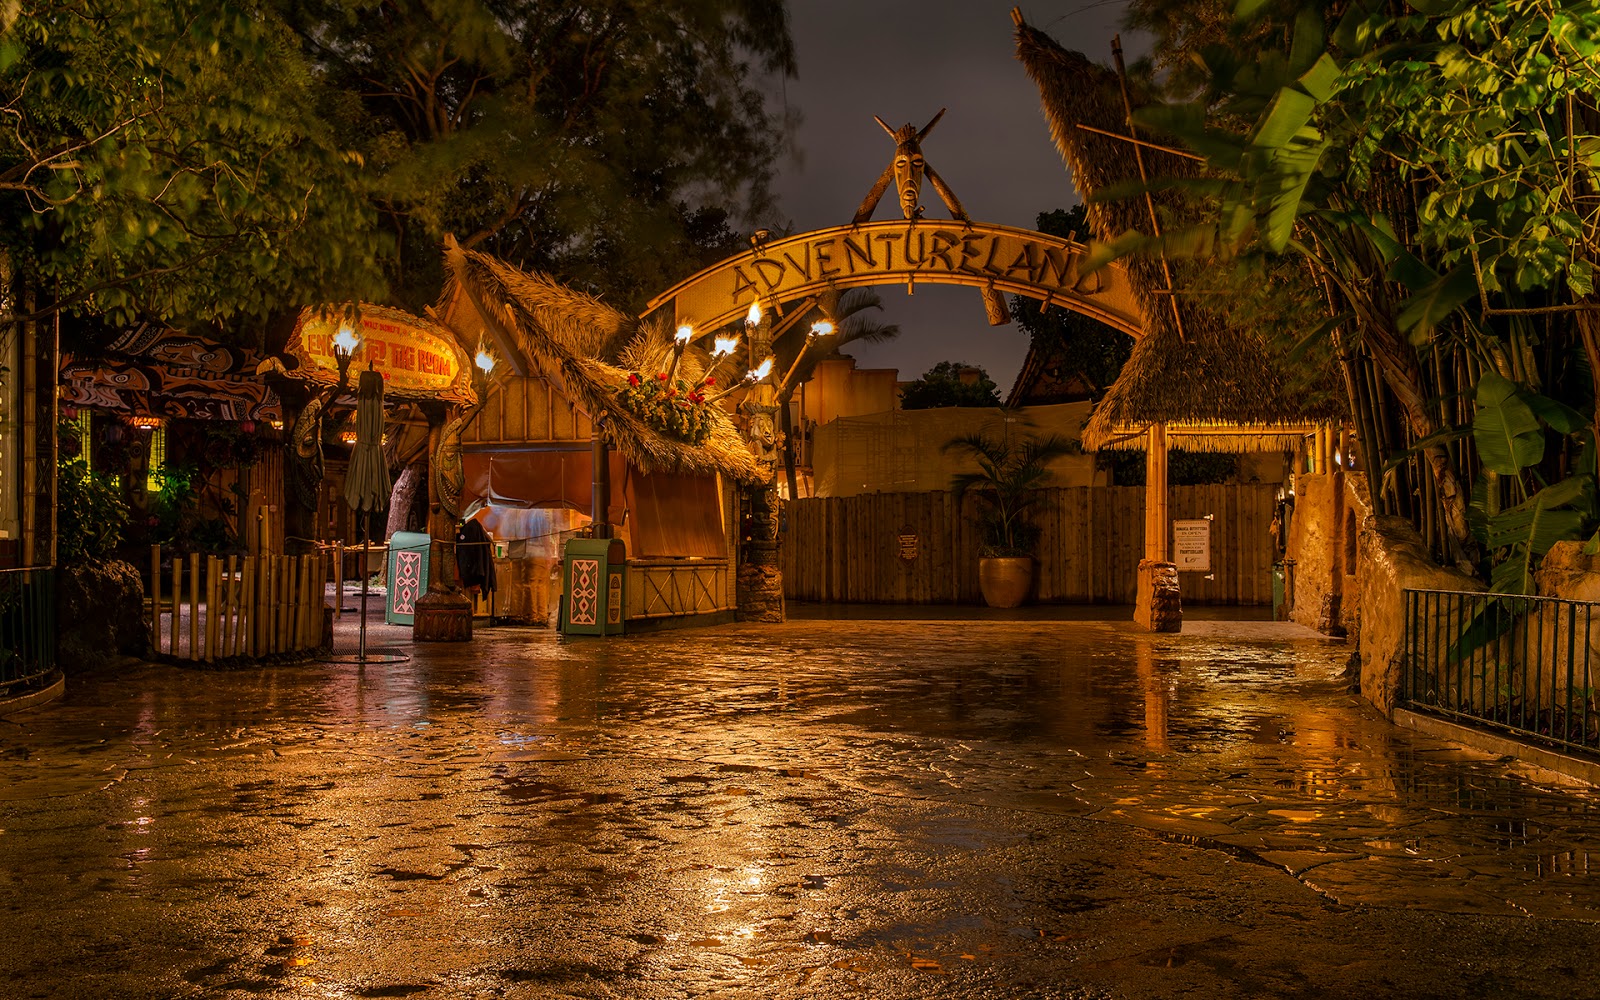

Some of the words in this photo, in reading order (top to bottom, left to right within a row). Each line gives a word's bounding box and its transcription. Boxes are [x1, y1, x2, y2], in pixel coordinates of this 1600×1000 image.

[732, 229, 1104, 304] ADVENTURELAND
[388, 342, 415, 372] TIKI
[418, 349, 451, 377] ROOM
